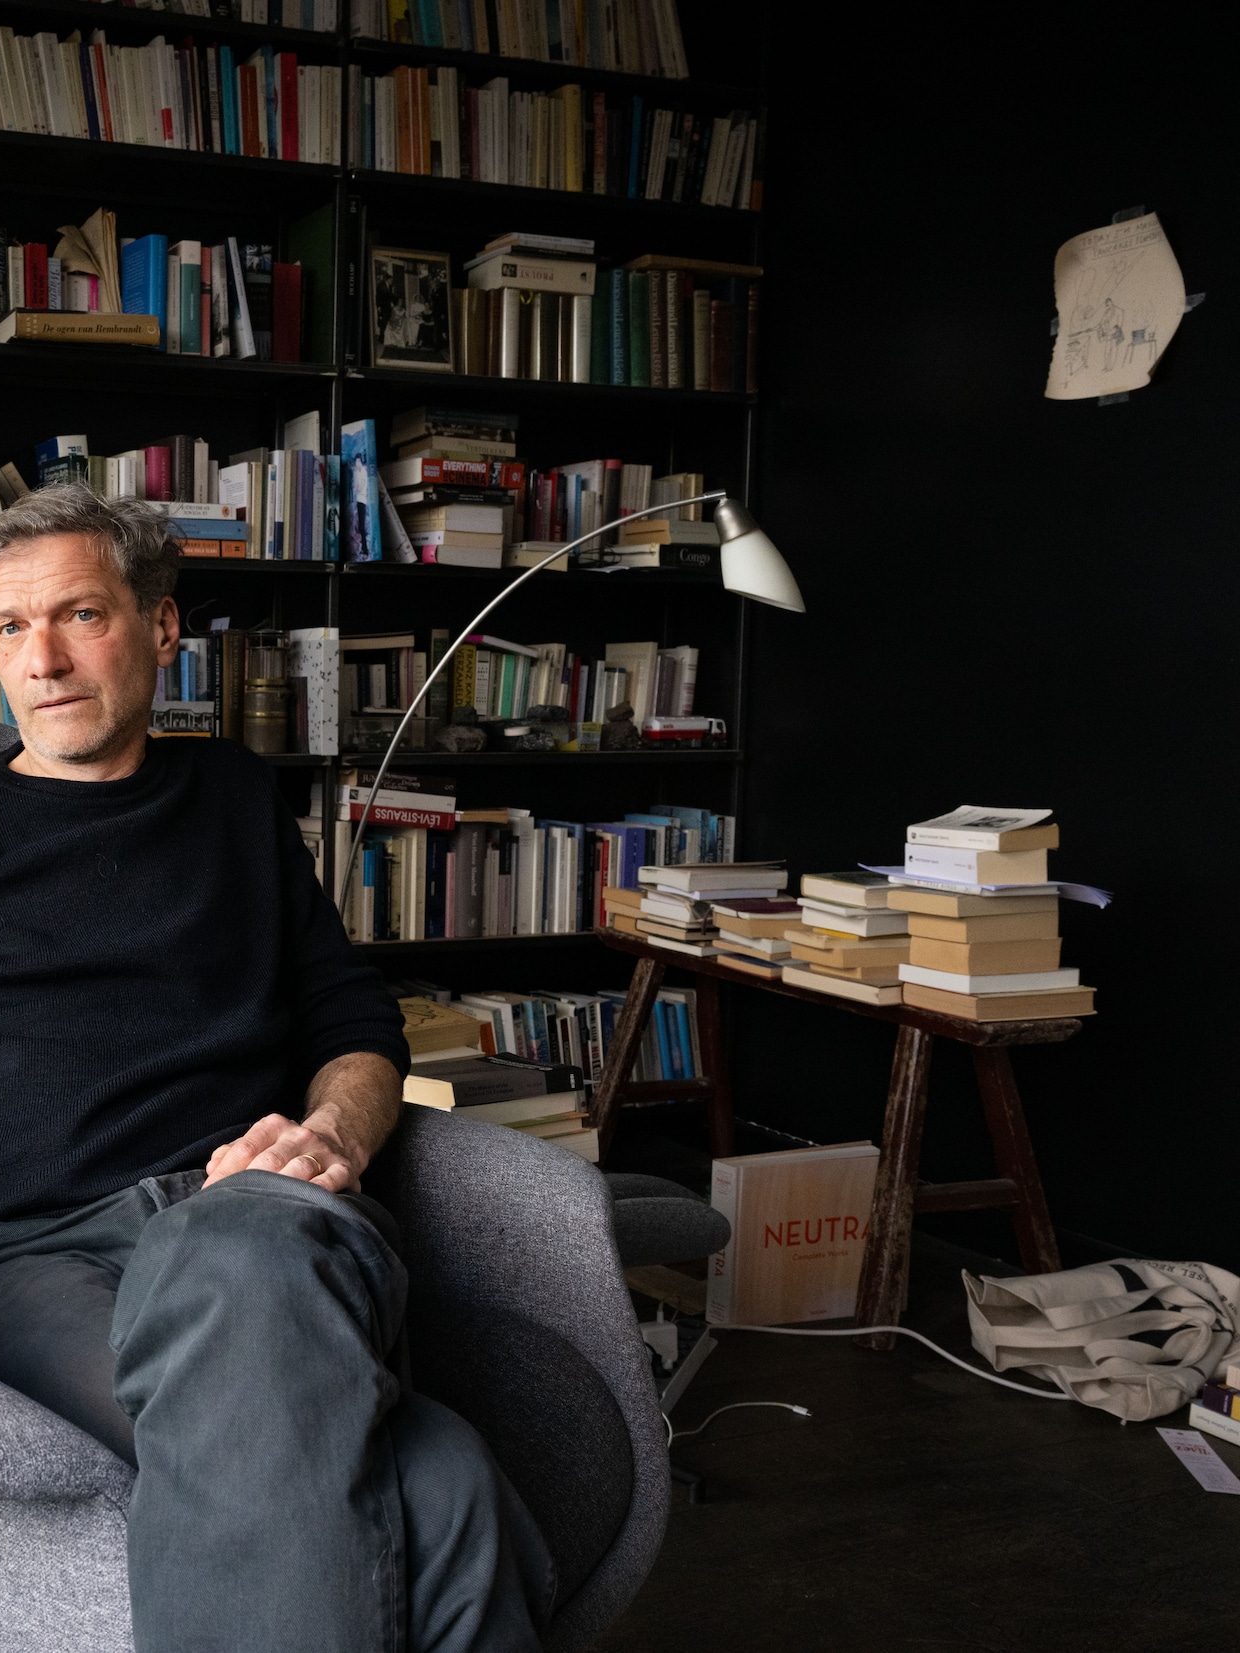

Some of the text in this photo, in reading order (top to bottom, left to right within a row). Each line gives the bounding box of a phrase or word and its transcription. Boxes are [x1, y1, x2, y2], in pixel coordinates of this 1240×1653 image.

[49, 269, 61, 310] Wagner
[613, 269, 623, 297] Diaries
[650, 272, 660, 301] Diaries
[667, 272, 677, 304] Diaries
[614, 299, 623, 317] and
[651, 302, 661, 320] and
[667, 304, 677, 321] and
[42, 324, 54, 333] De
[57, 326, 75, 334] ogen
[96, 324, 142, 333] Rembrandt
[613, 318, 623, 347] Letters
[651, 321, 661, 352] Letters
[668, 322, 677, 353] Letters
[443, 461, 486, 473] EVERYTHING
[448, 472, 486, 485] CINEMA
[680, 548, 710, 566] Congo
[464, 649, 473, 679] FRANZ
[455, 649, 464, 706] VERZAMELD
[375, 808, 440, 828] LÉVI-STRAUSS
[793, 1250, 849, 1261] Complete Works
